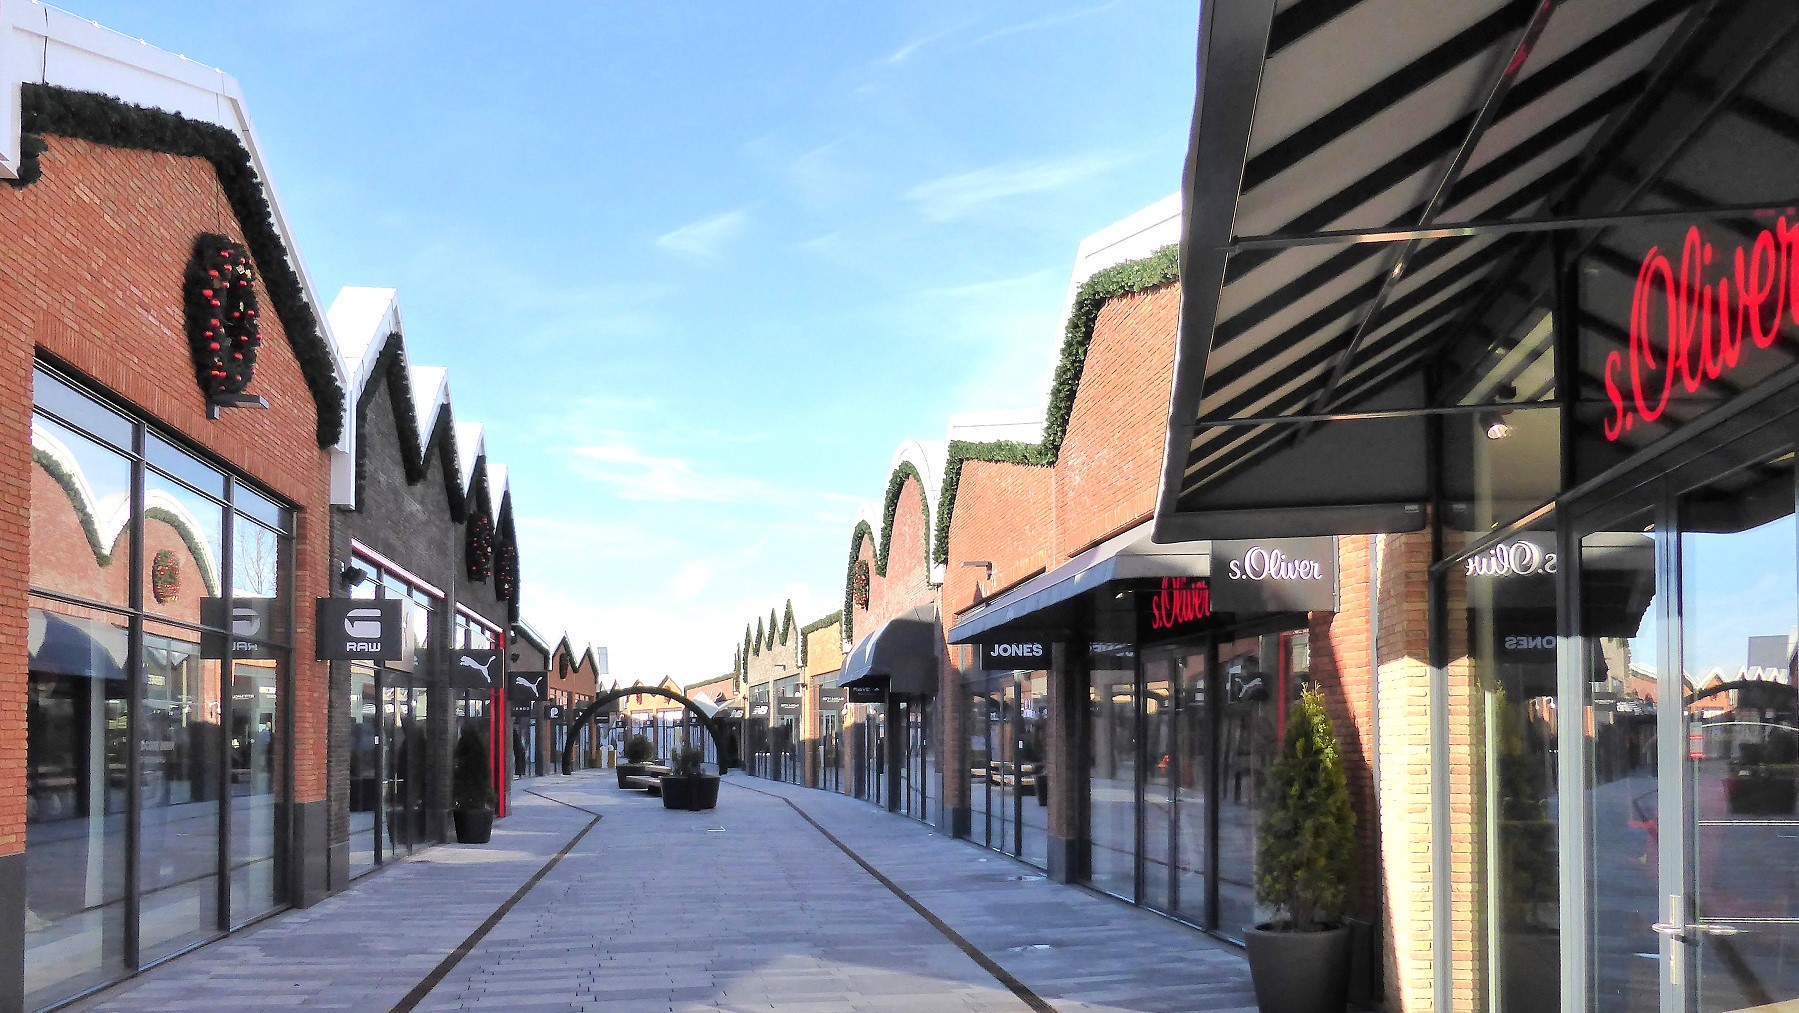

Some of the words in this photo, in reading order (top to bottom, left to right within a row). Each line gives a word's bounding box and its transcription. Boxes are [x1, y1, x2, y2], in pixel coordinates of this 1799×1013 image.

[1228, 546, 1323, 580] s.Oliver
[346, 642, 381, 652] RAW
[990, 643, 1043, 657] JONES
